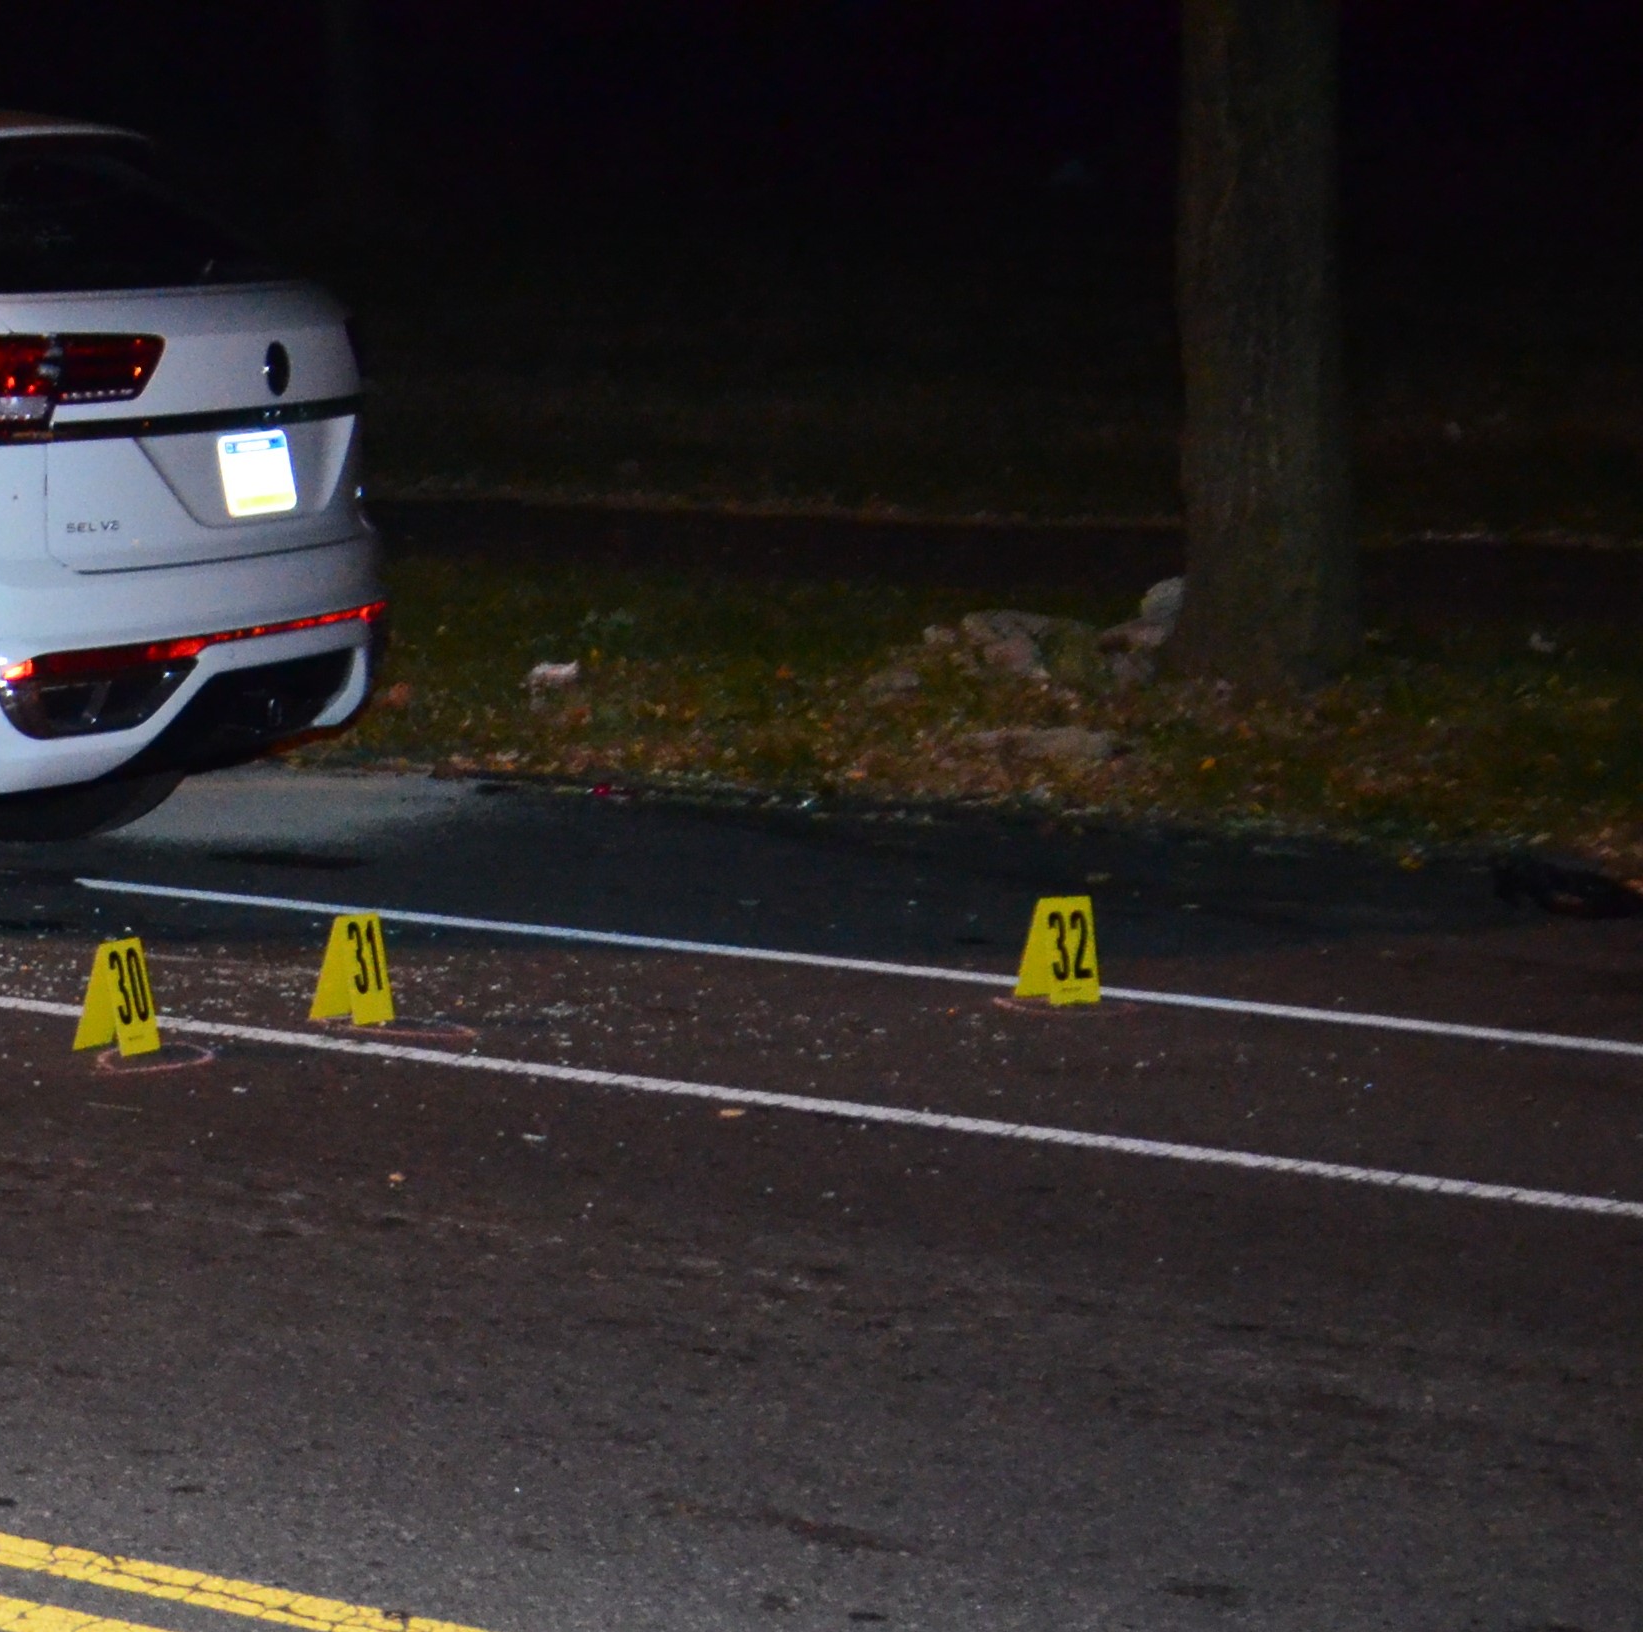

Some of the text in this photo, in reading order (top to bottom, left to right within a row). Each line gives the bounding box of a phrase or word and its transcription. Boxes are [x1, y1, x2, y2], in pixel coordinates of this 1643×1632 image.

[66, 522, 96, 533] SEL
[348, 921, 382, 994] 31
[1048, 910, 1093, 981] 32
[109, 948, 149, 1025] 30
